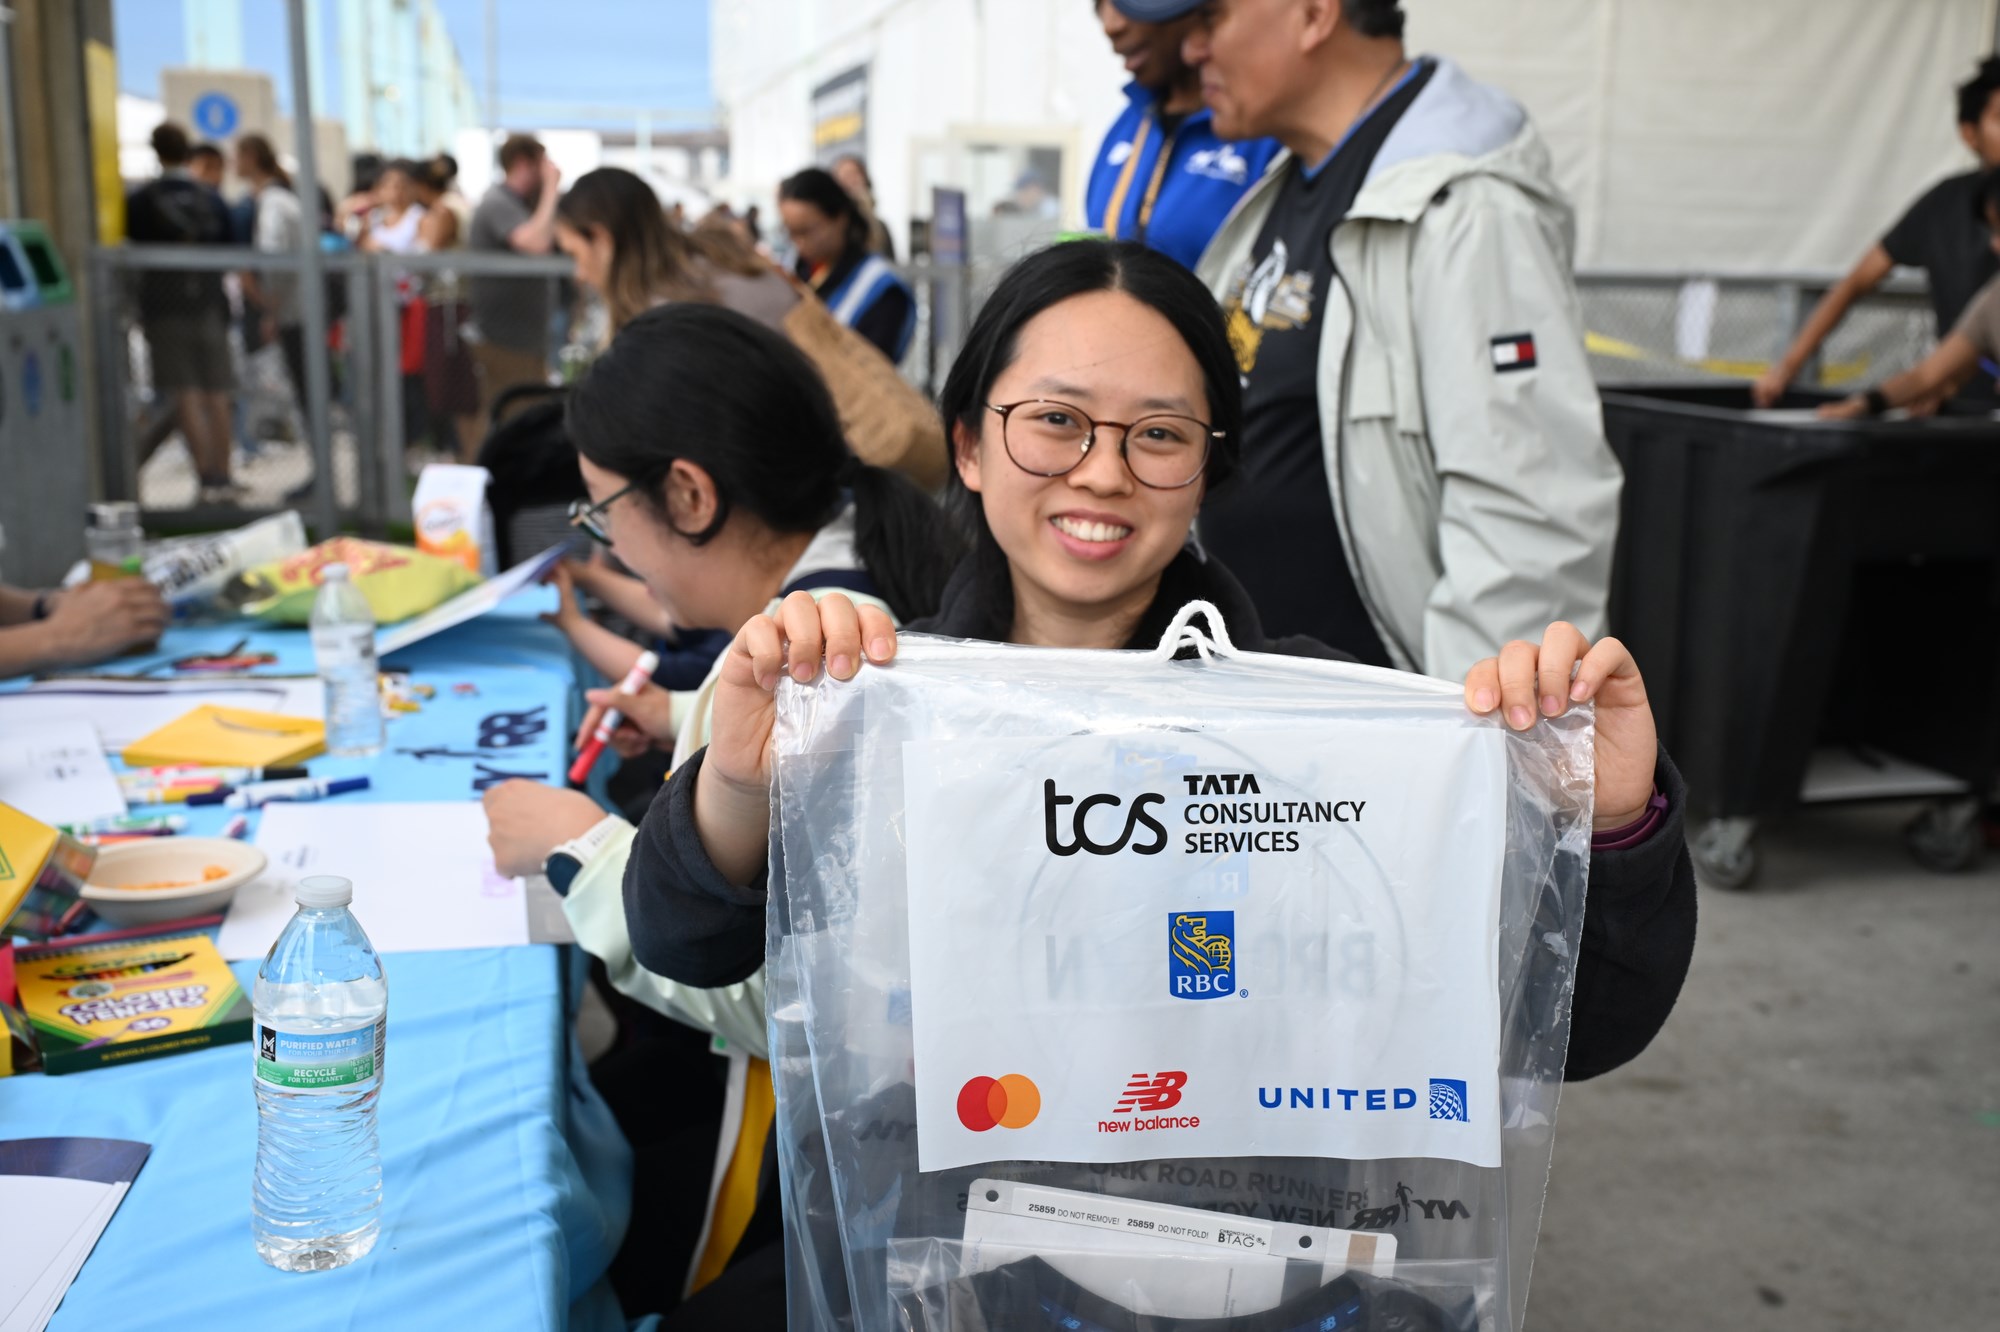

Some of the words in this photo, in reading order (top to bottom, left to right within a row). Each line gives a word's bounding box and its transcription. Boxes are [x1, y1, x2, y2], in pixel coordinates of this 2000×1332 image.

[1183, 773, 1261, 796] TATA
[1044, 778, 1168, 856] tcs
[1183, 801, 1366, 825] CONSULTANCY
[1184, 830, 1300, 854] SERVICES
[1176, 973, 1229, 994] RBC
[280, 1039, 323, 1051] PURIFIED
[326, 1037, 358, 1049] WATER
[293, 1067, 337, 1077] RECYCLE
[316, 1074, 344, 1083] PLANET
[1258, 1087, 1417, 1111] UNITED
[1098, 1120, 1132, 1133] new
[1134, 1115, 1200, 1131] balance
[1157, 1163, 1238, 1190] ROAD
[1028, 1203, 1056, 1215] 25859
[1057, 1208, 1069, 1218] DO
[1069, 1210, 1086, 1220] NOT
[1086, 1212, 1120, 1226] REMOVE!
[1127, 1218, 1155, 1230] 25859
[1158, 1224, 1169, 1233] DO
[1170, 1225, 1186, 1236] NOT
[1187, 1227, 1209, 1239] FOLD!
